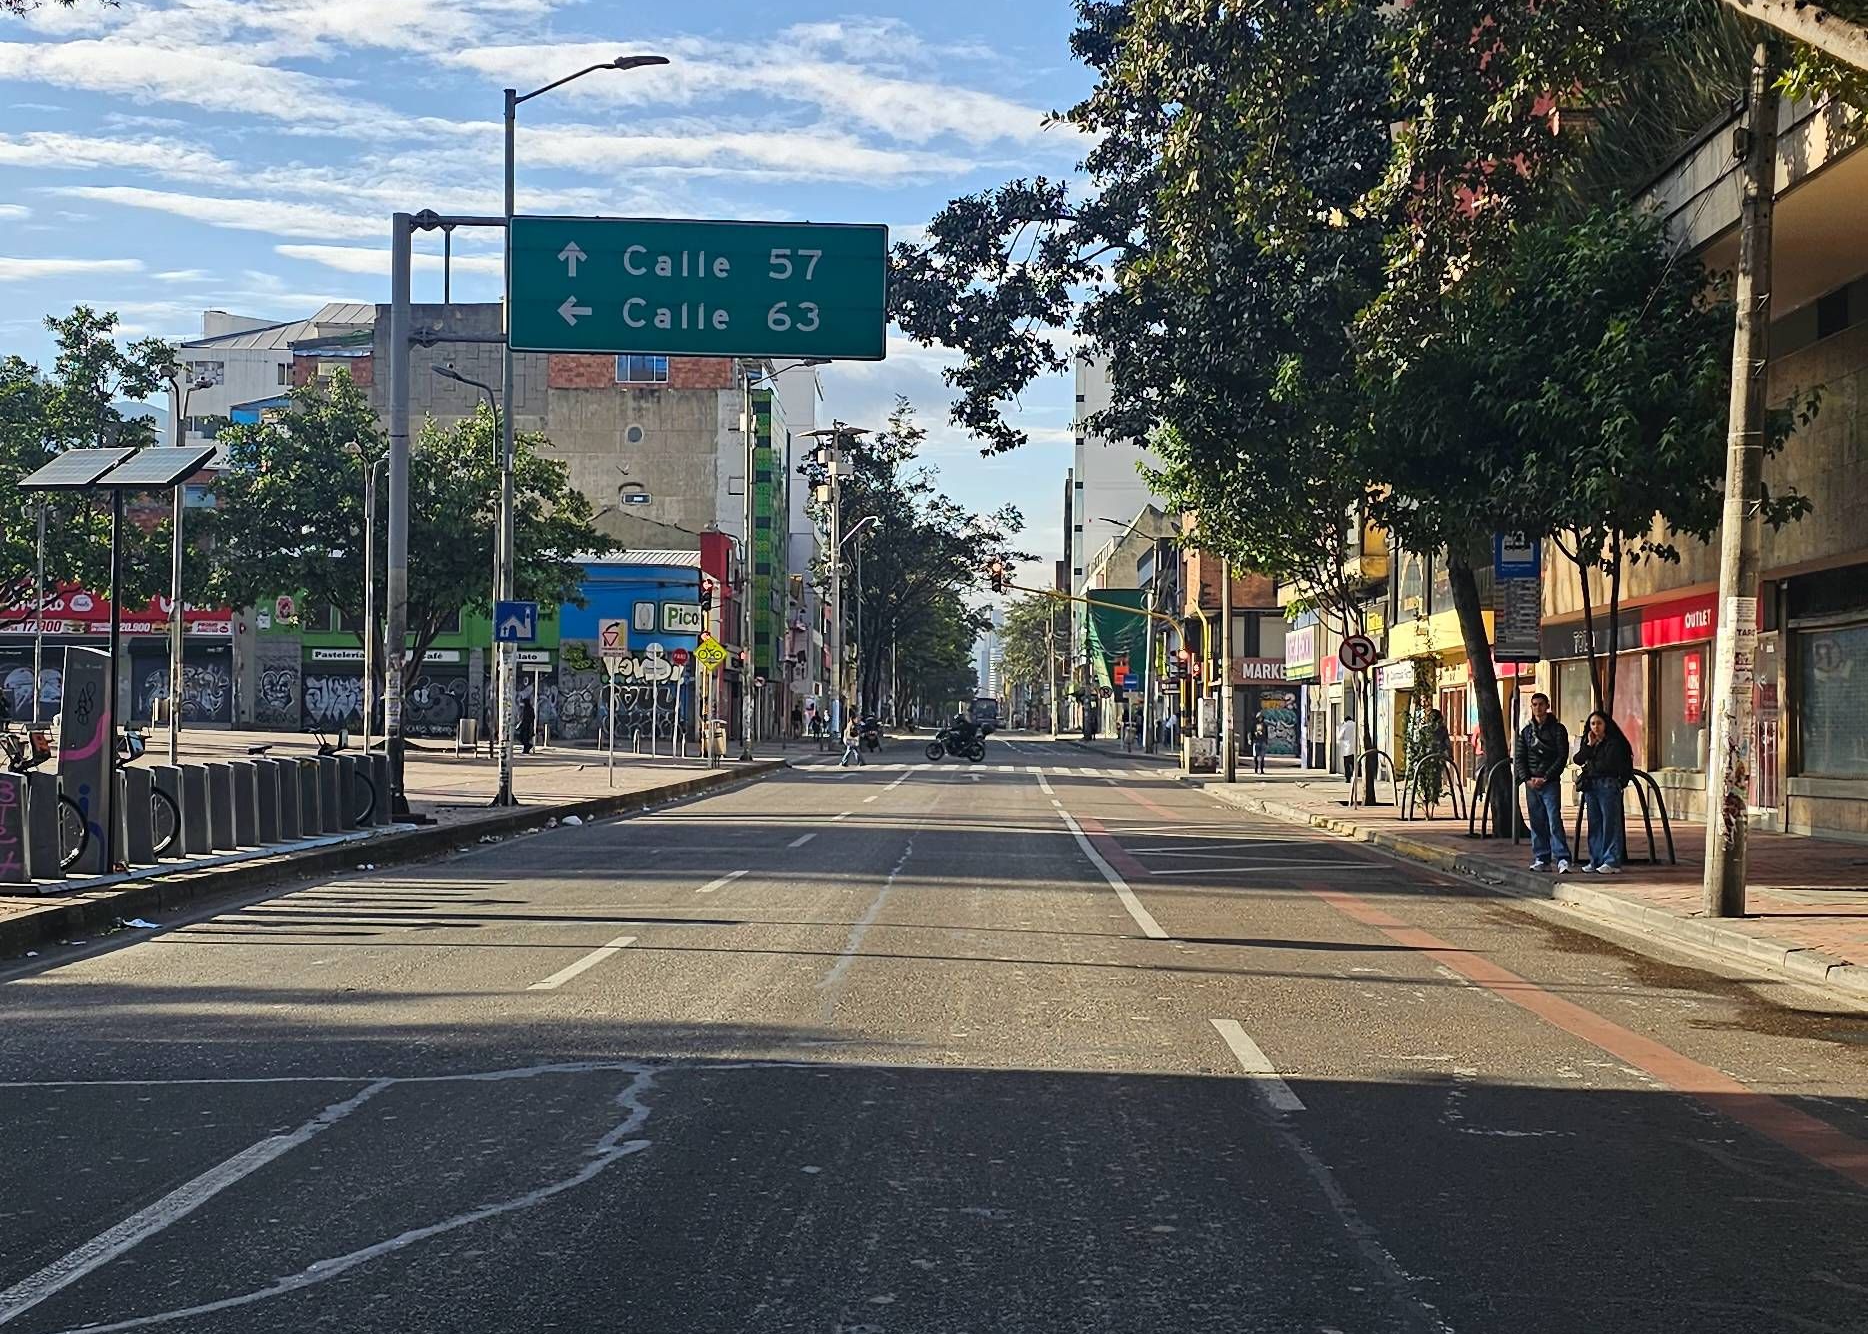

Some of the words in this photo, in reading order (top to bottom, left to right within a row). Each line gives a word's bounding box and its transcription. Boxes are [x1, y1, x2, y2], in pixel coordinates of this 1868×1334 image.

[623, 244, 731, 278] Calle
[768, 248, 823, 280] 57
[622, 297, 730, 330] Calle
[767, 301, 820, 331] 63
[667, 606, 699, 628] Pico
[1684, 608, 1712, 629] OUTLET
[424, 651, 443, 660] afé
[1242, 663, 1287, 679] MARKE
